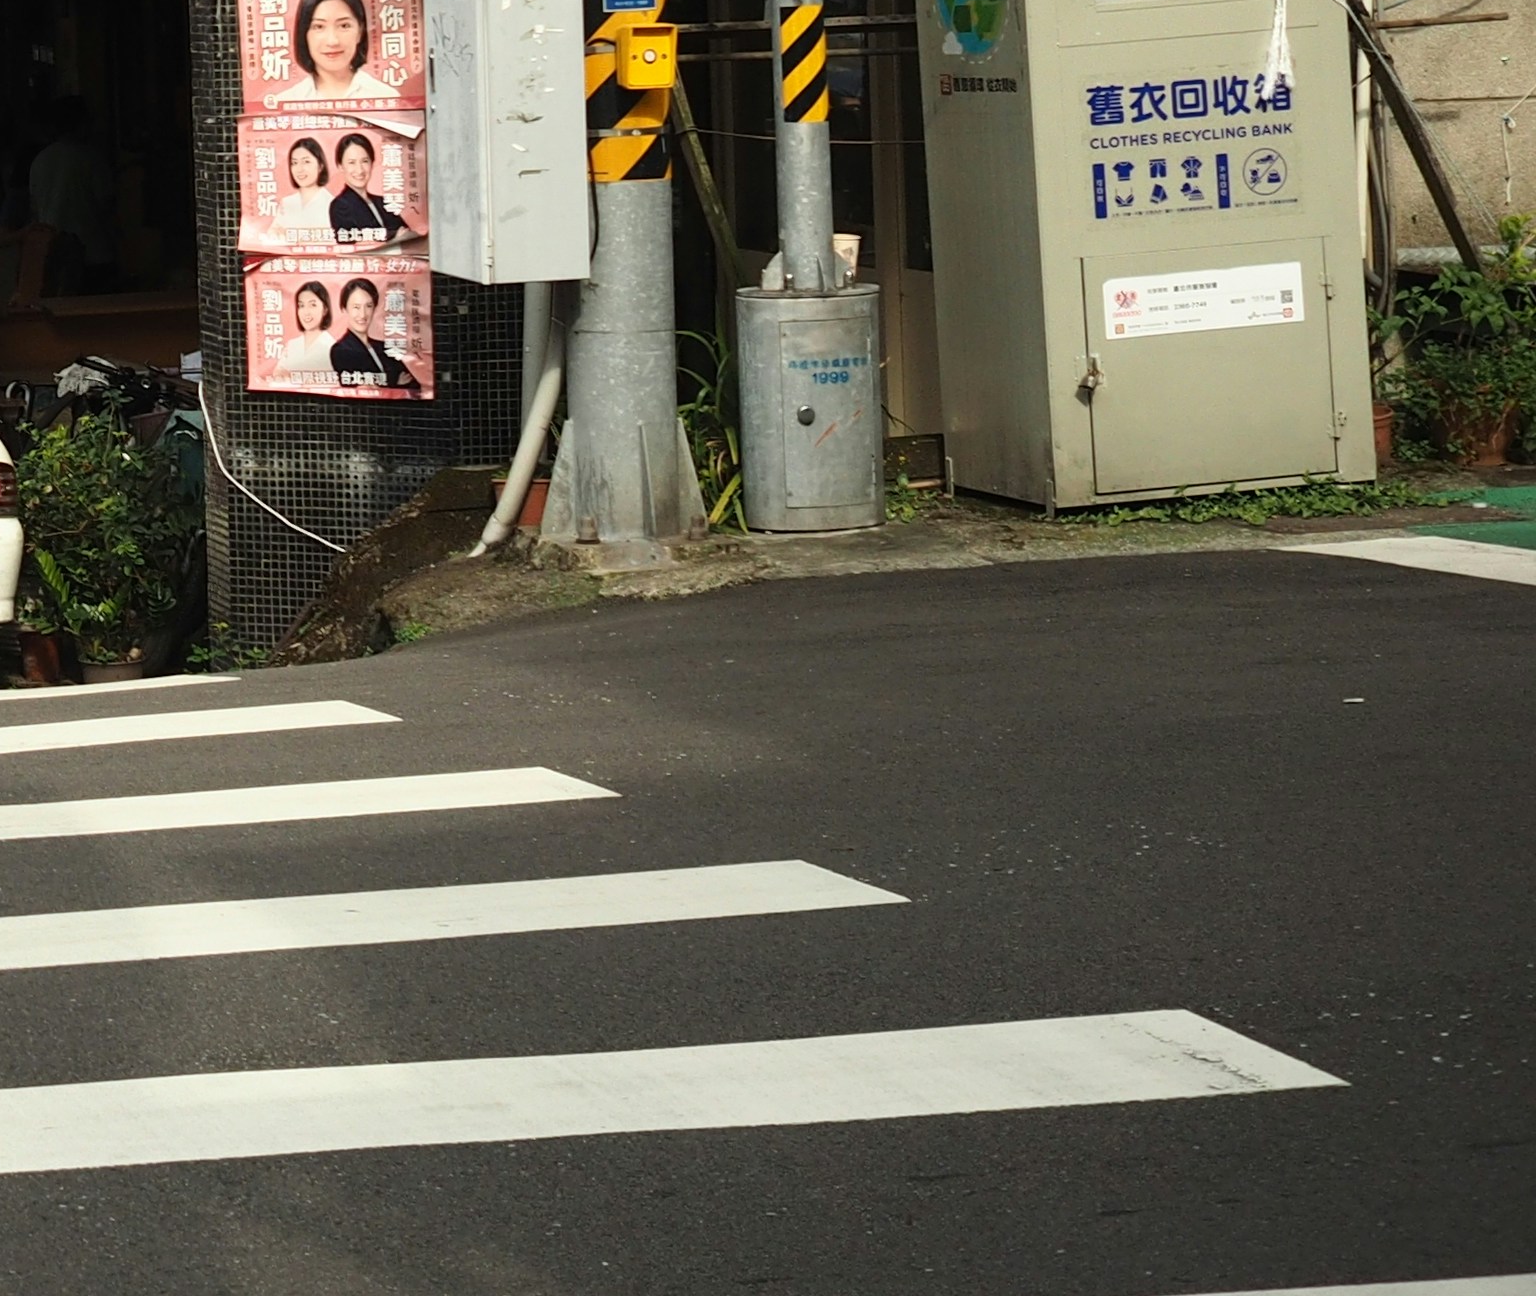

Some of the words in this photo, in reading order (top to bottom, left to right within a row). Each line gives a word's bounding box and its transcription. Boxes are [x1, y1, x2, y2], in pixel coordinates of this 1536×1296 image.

[1086, 73, 1292, 126] 舊衣回收箱
[1090, 134, 1158, 150] CLOTHES
[1163, 126, 1247, 144] RECYCLING
[1252, 123, 1293, 137] BANK
[254, 147, 278, 217] 劉品妡
[381, 144, 406, 216] 蕭美琴
[261, 289, 284, 359] 劉品妡
[384, 289, 408, 360] 蕭美琴
[812, 371, 849, 384] 1999
